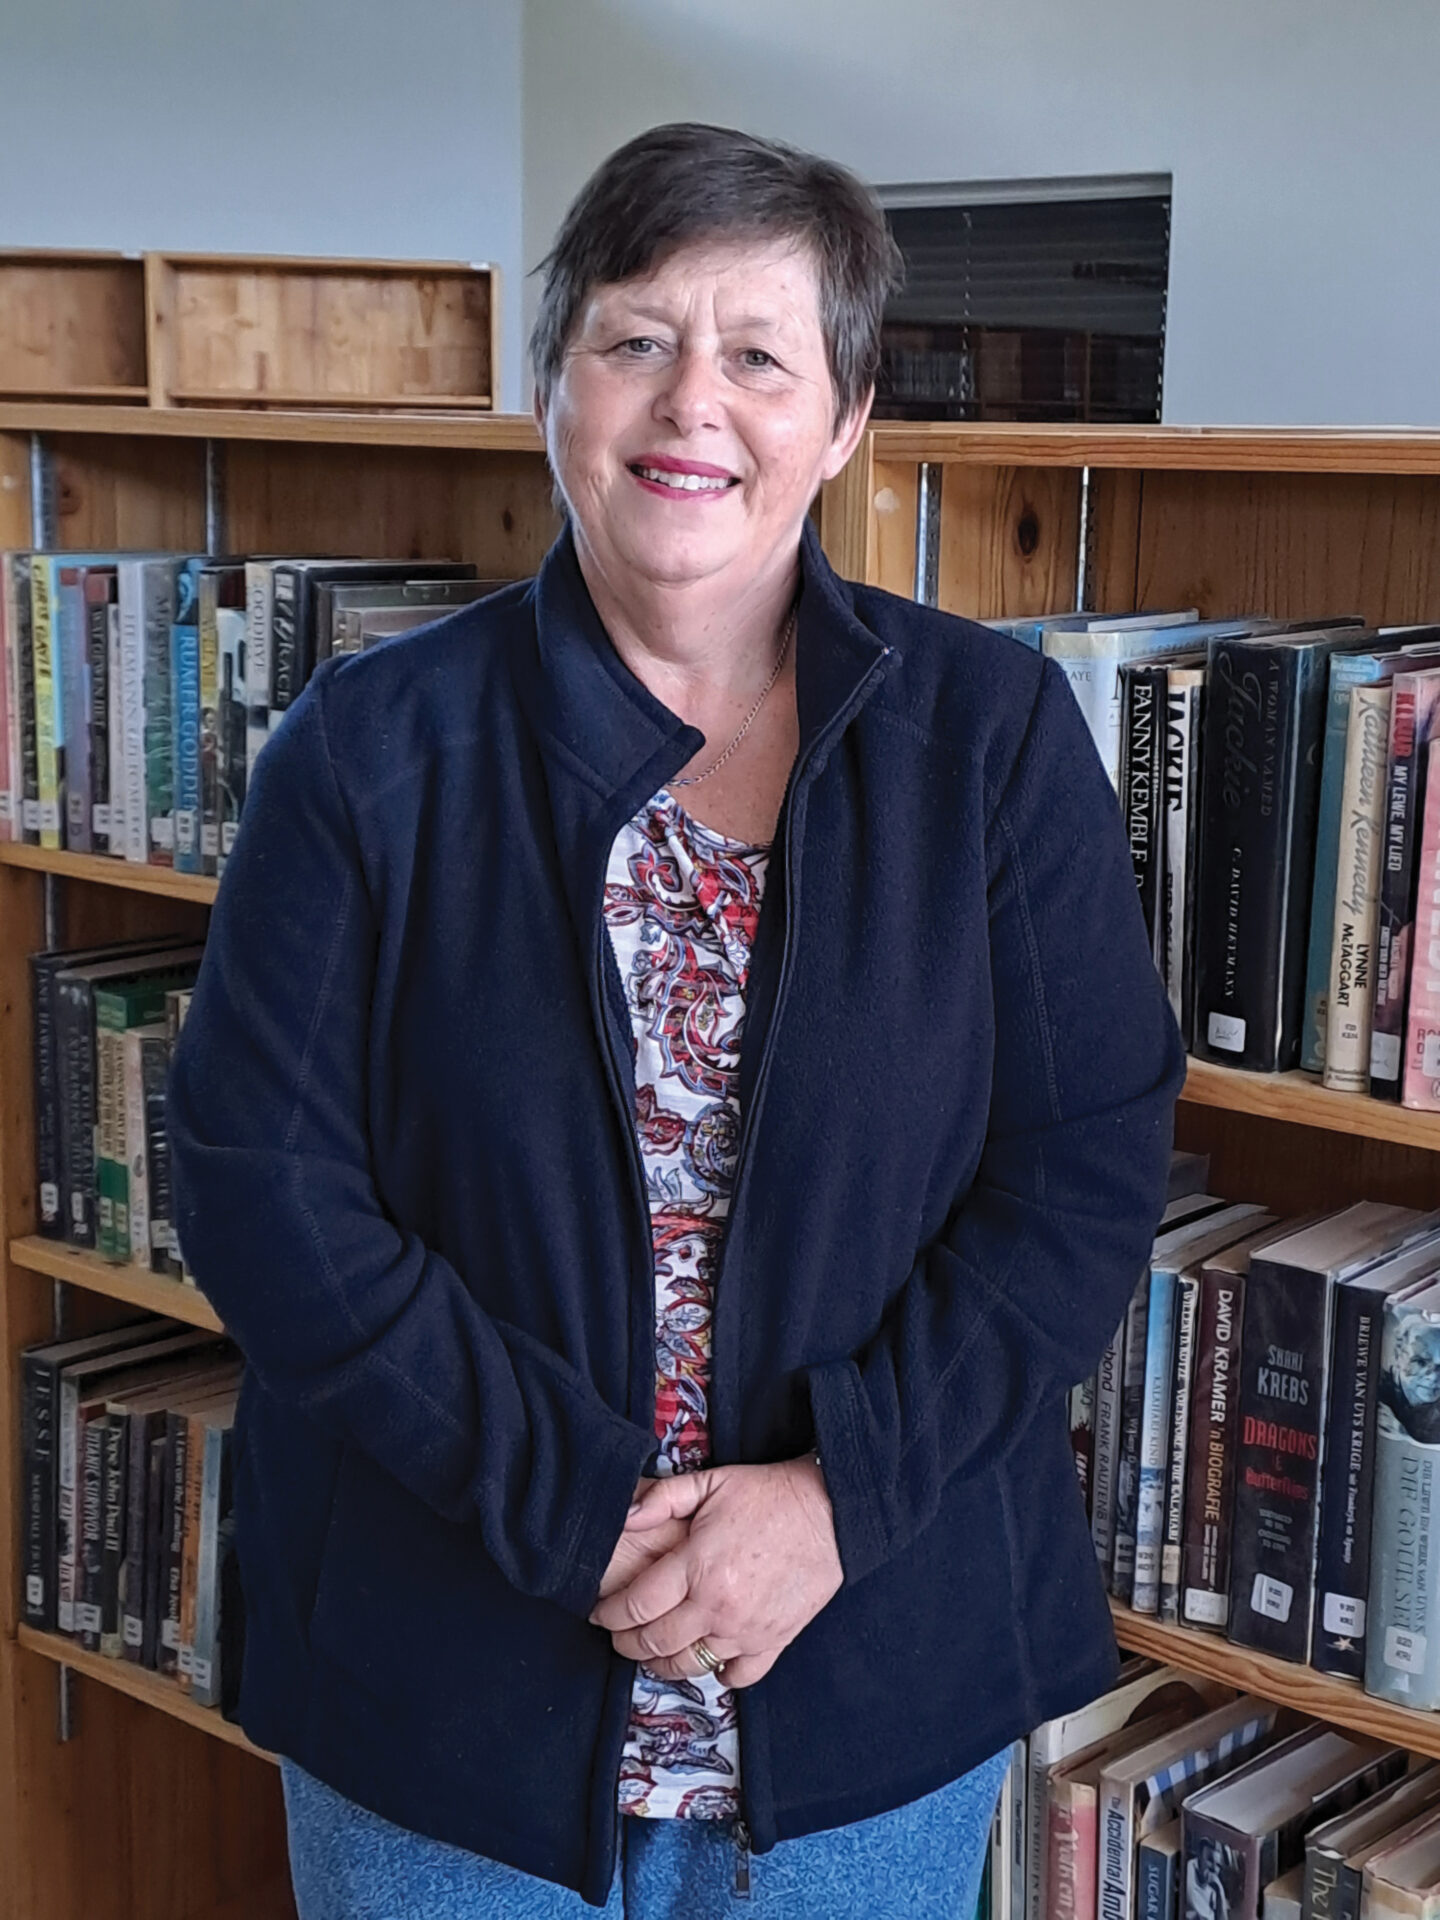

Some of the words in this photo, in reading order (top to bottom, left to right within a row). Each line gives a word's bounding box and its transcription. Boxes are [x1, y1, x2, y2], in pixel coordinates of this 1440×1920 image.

[124, 613, 137, 718] HERMANN
[180, 635, 199, 718] RUMER
[1069, 671, 1092, 682] AYE
[1268, 659, 1280, 671] A
[1132, 684, 1153, 766] FANNY
[1218, 652, 1263, 809] Jackie
[1264, 680, 1279, 745] WOMAN
[1358, 696, 1388, 808] Kathleen
[1394, 765, 1408, 784] MY
[1260, 753, 1275, 817] NAMED
[1129, 770, 1151, 863] KEMBLE
[1389, 824, 1405, 844] MY
[1342, 808, 1379, 917] Kennedy
[1387, 845, 1402, 871] LIED
[1229, 866, 1241, 918] DAVID
[1224, 921, 1239, 998] HEYMANN
[1337, 922, 1354, 1008] McTAGGART
[1354, 943, 1370, 989] LYNNE
[1215, 1289, 1234, 1343] DAVID
[1356, 1316, 1371, 1367] BRIEWE
[1209, 1345, 1230, 1424] KRAMER
[1257, 1367, 1309, 1406] KREBS
[1354, 1371, 1368, 1398] VAN
[36, 1369, 51, 1460] JESSE
[1097, 1401, 1112, 1451] FRANK
[1209, 1427, 1225, 1441] 'n
[1243, 1416, 1318, 1460] DRAGONS
[1352, 1402, 1365, 1427] UYS
[84, 1428, 101, 1477] TITANIC
[105, 1426, 122, 1466] Pope
[175, 1439, 186, 1467] Lion
[1173, 1450, 1184, 1464] IN
[1349, 1430, 1363, 1472] KRIGE
[1421, 1459, 1433, 1480] DIE
[105, 1467, 121, 1502] John
[174, 1485, 184, 1504] the
[1095, 1453, 1111, 1522] RAUTENB
[1204, 1442, 1225, 1521] BIOGRAFIE
[1401, 1456, 1420, 1500] DIE
[82, 1478, 101, 1541] SURVIVOR
[104, 1503, 121, 1539] Paul
[170, 1505, 184, 1553] Landing
[1417, 1533, 1430, 1566] WERK
[1416, 1568, 1428, 1591] VAN
[1106, 1809, 1126, 1881] Accidental
[1147, 1864, 1161, 1914] SUGAR
[1311, 1867, 1338, 1909] The
